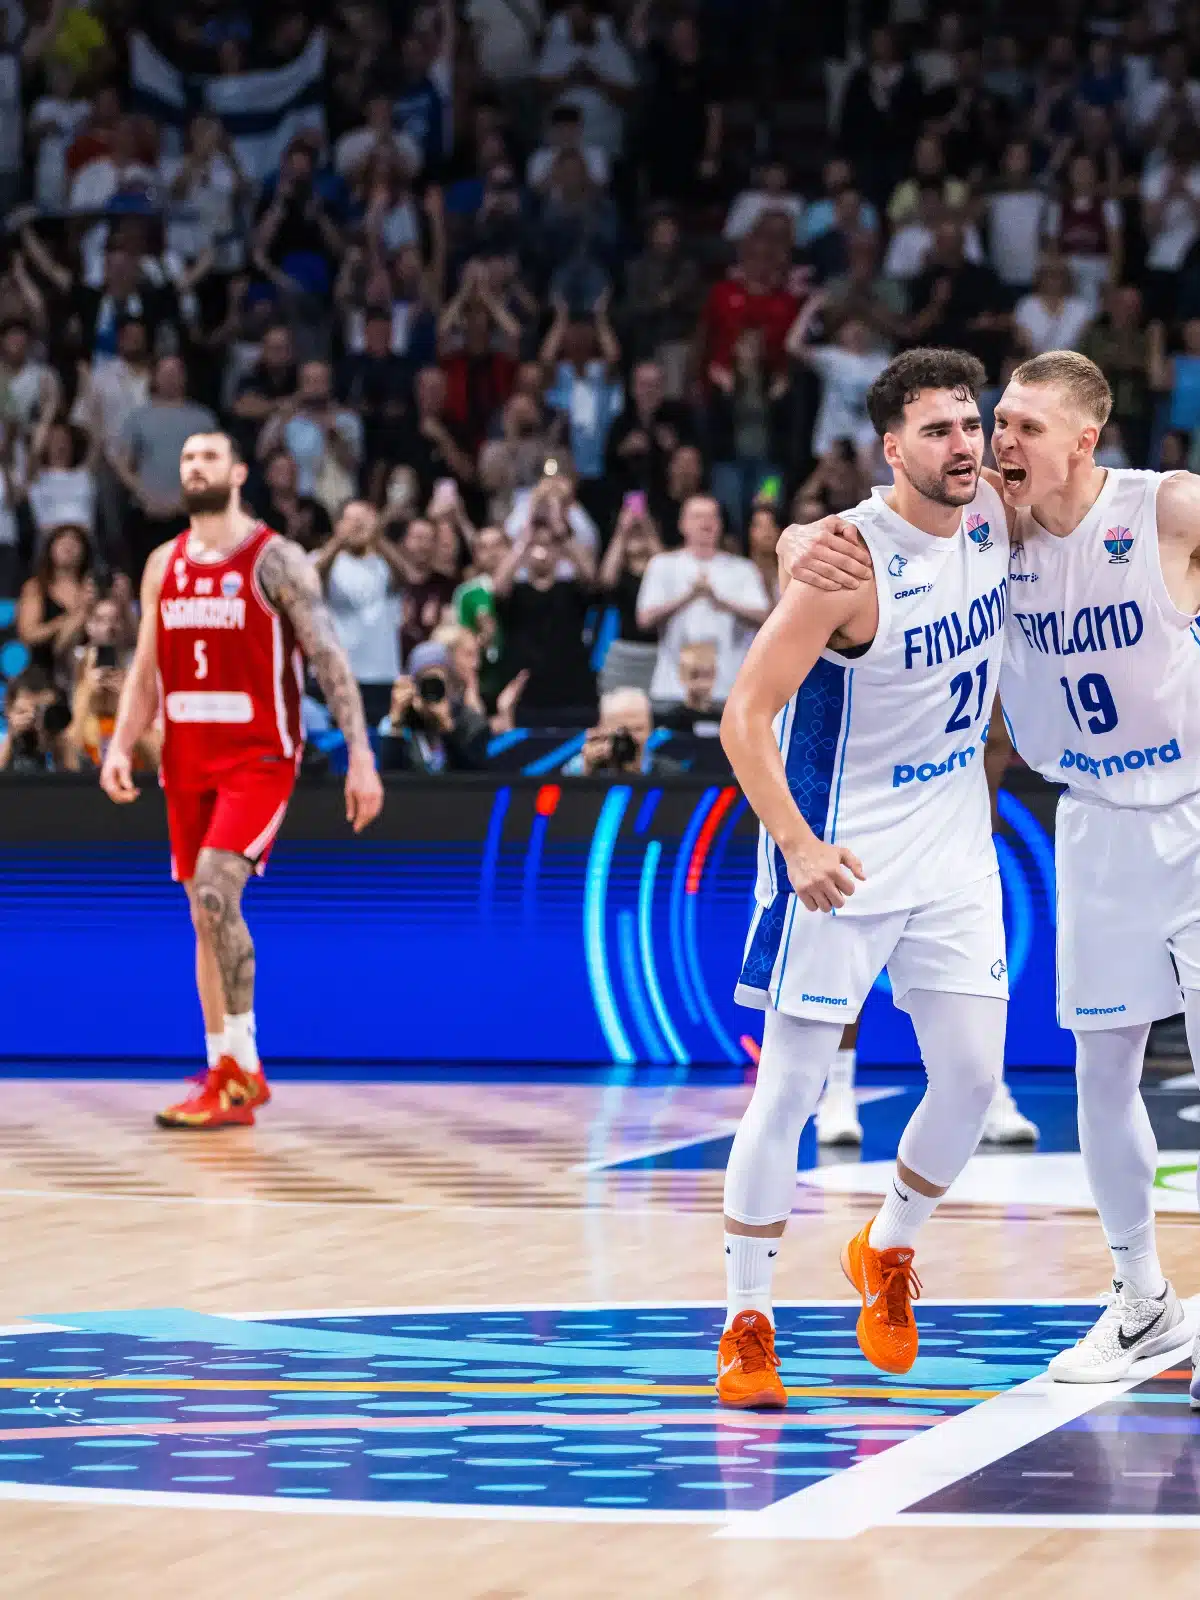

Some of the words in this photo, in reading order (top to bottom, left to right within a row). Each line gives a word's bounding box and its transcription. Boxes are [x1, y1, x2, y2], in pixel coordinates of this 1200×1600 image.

[894, 585, 927, 600] CRAFT
[1013, 600, 1144, 655] FINLAND
[194, 639, 208, 680] 5
[945, 658, 988, 734] 21
[1060, 672, 1119, 735] 19
[801, 993, 848, 1006] postnord
[1075, 1004, 1127, 1016] postnord
